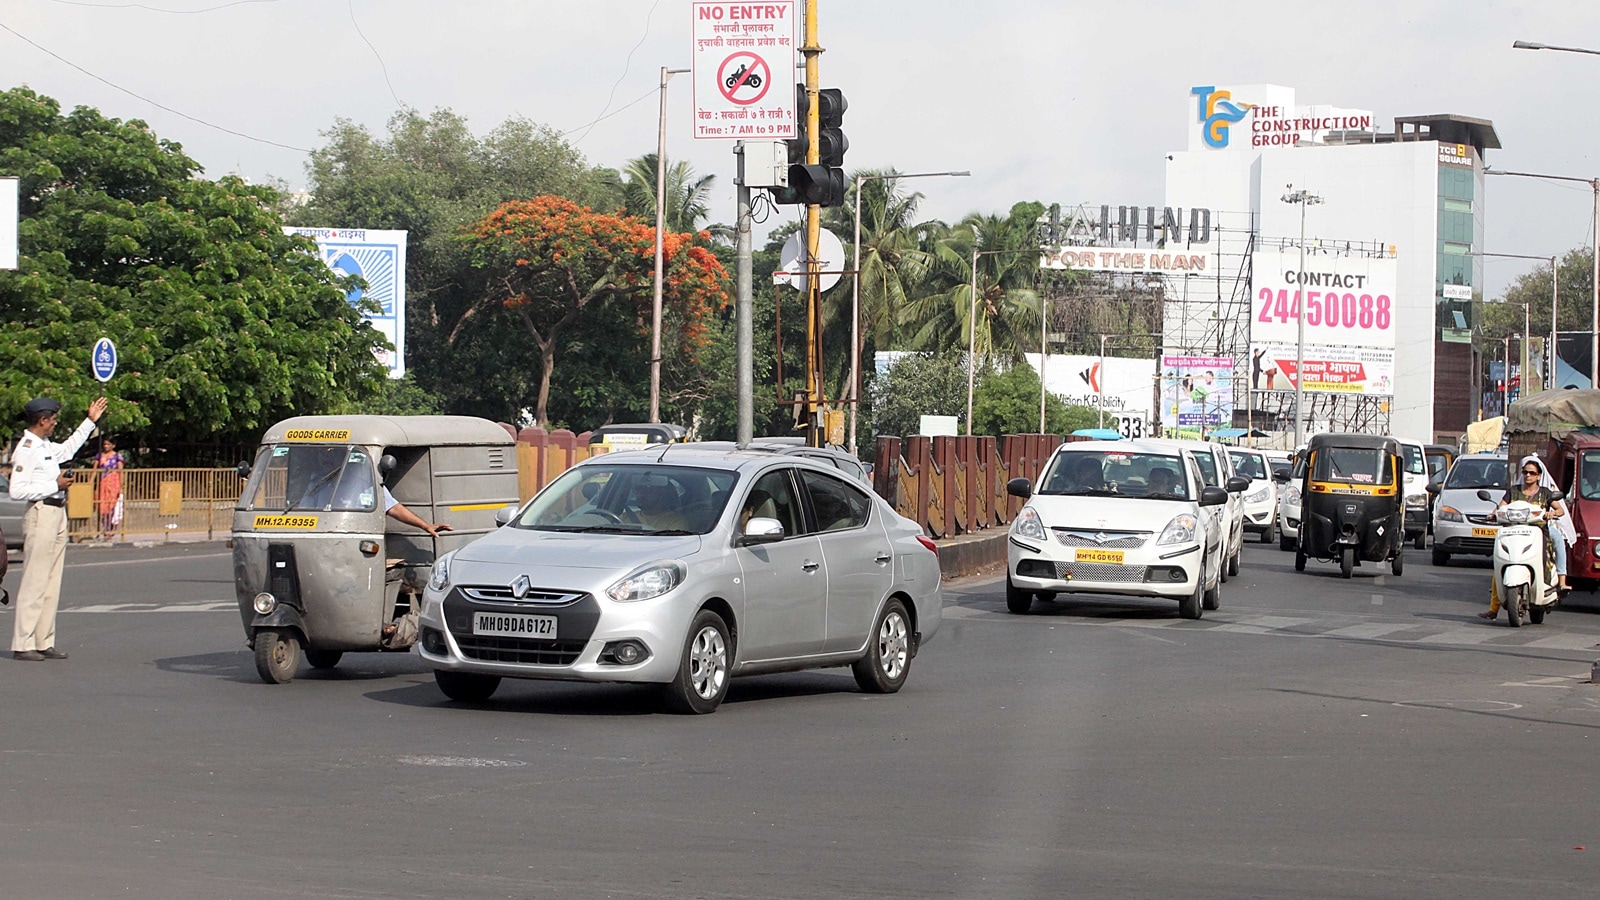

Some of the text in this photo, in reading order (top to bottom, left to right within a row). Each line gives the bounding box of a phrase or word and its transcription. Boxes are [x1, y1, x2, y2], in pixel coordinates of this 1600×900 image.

[699, 5, 787, 20] NO ENTRY
[698, 34, 790, 51] दुचाकी वाहनास प्रवेश बंद
[698, 108, 712, 120] वेळ
[720, 107, 748, 119] सकाळी
[759, 107, 765, 119] ते
[767, 107, 783, 119] रात्री
[1252, 106, 1279, 118] THE
[699, 126, 722, 134] Time
[730, 125, 736, 134] 7
[739, 125, 753, 134] AM
[768, 125, 774, 133] 9
[777, 124, 791, 133] PM
[1252, 116, 1370, 132] CONSTRUCTION
[1252, 133, 1300, 146] GROUP
[1440, 146, 1457, 154] TCG
[1439, 155, 1472, 165] SQUARE
[1100, 252, 1145, 269] THE
[1150, 254, 1206, 270] MAN
[1285, 270, 1366, 289] CONTACT
[1258, 287, 1391, 330] 24450088
[314, 431, 348, 439] CARRIER
[256, 518, 315, 526] MH.12.F.9355
[479, 616, 552, 634] MH09DA6127
